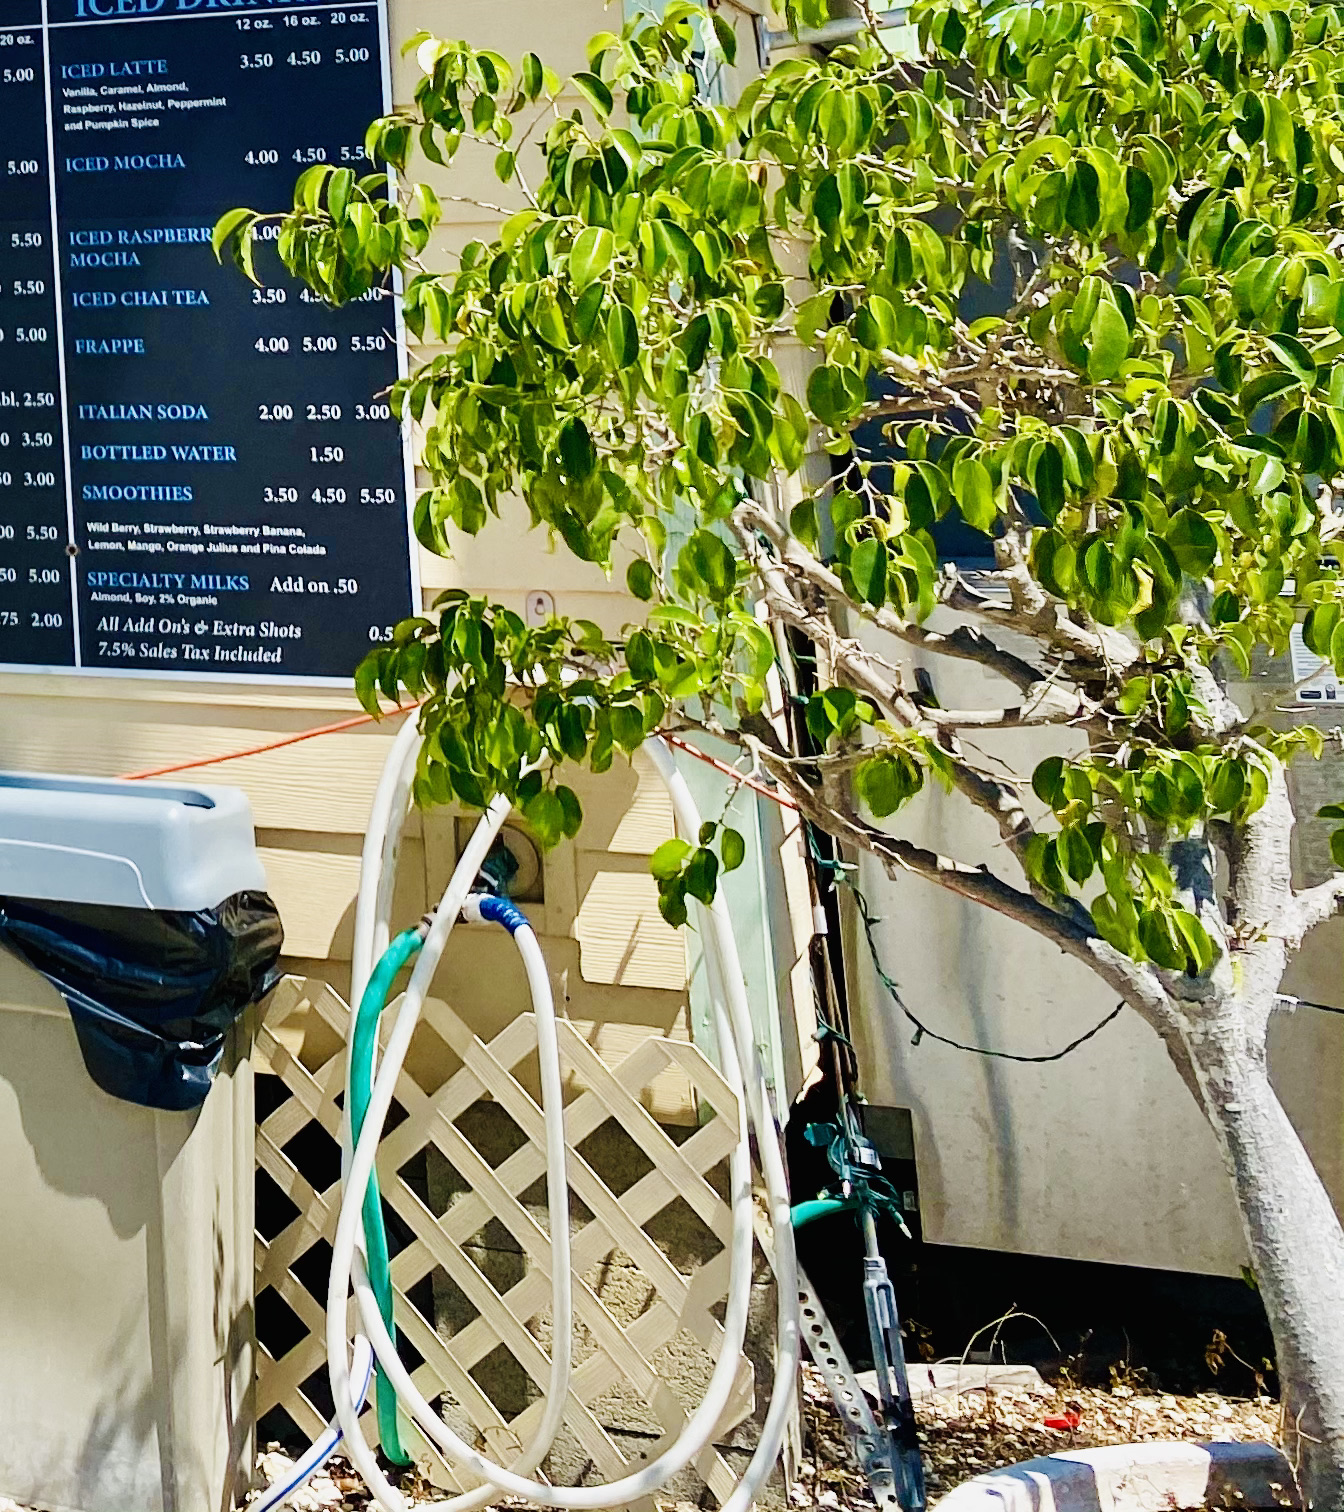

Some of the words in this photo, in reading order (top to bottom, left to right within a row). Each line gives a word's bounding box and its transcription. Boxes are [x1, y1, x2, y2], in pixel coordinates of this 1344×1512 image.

[235, 18, 251, 31] 12
[253, 18, 273, 31] oz.
[283, 15, 297, 27] 16
[301, 16, 321, 27] oz.
[330, 12, 346, 24] 20
[350, 12, 370, 24] oz.
[61, 62, 105, 79] ICED
[110, 59, 168, 77] LATTE
[239, 53, 274, 70] 3.50
[286, 50, 321, 67] 4.50
[334, 47, 370, 64] 5.00
[3, 67, 34, 83] 5.00
[167, 96, 227, 111] Peppermint
[66, 156, 109, 173] ICED
[114, 153, 186, 170] MOCHA
[244, 149, 279, 165] 4.00
[291, 147, 327, 163] 4.50
[11, 233, 42, 248] 5.50
[69, 230, 113, 246] ICED
[70, 251, 141, 268] MOCHA
[72, 291, 116, 307] ICED
[120, 290, 169, 306] CHAI
[171, 289, 210, 305] TEA
[252, 288, 286, 304] 3.50
[16, 328, 47, 342] 5.00
[75, 338, 145, 355] FRAPPE
[254, 337, 290, 353] 4.00
[302, 336, 338, 352] 5.00
[350, 336, 386, 352] 5.50
[23, 392, 55, 407] 2.50
[78, 404, 153, 420] ITALIAN
[157, 404, 209, 420] SODA
[259, 404, 294, 421] 2.00
[306, 404, 342, 421] 2.50
[355, 404, 390, 420] 3.00
[22, 432, 53, 447] 3.50
[81, 445, 166, 461] BOTTLED
[170, 446, 237, 462] WATER
[23, 472, 55, 487] 3.00
[82, 485, 193, 501] SMOOTHIES
[263, 487, 299, 504] 3.50
[311, 487, 347, 504] 4.50
[360, 488, 396, 505] 5.50
[28, 569, 60, 584] 5.00
[87, 572, 186, 590] SPECIALTY
[190, 574, 250, 591] MILKS
[269, 576, 304, 594] Add
[308, 581, 329, 594] on
[97, 616, 119, 633] All
[122, 617, 155, 635] Add
[158, 618, 190, 635] On's
[213, 621, 256, 638] Extra
[259, 622, 302, 639] Shots
[98, 641, 136, 658] 7.5%
[139, 642, 178, 660] Sales
[181, 643, 210, 661] Tax
[214, 646, 283, 664] Included
